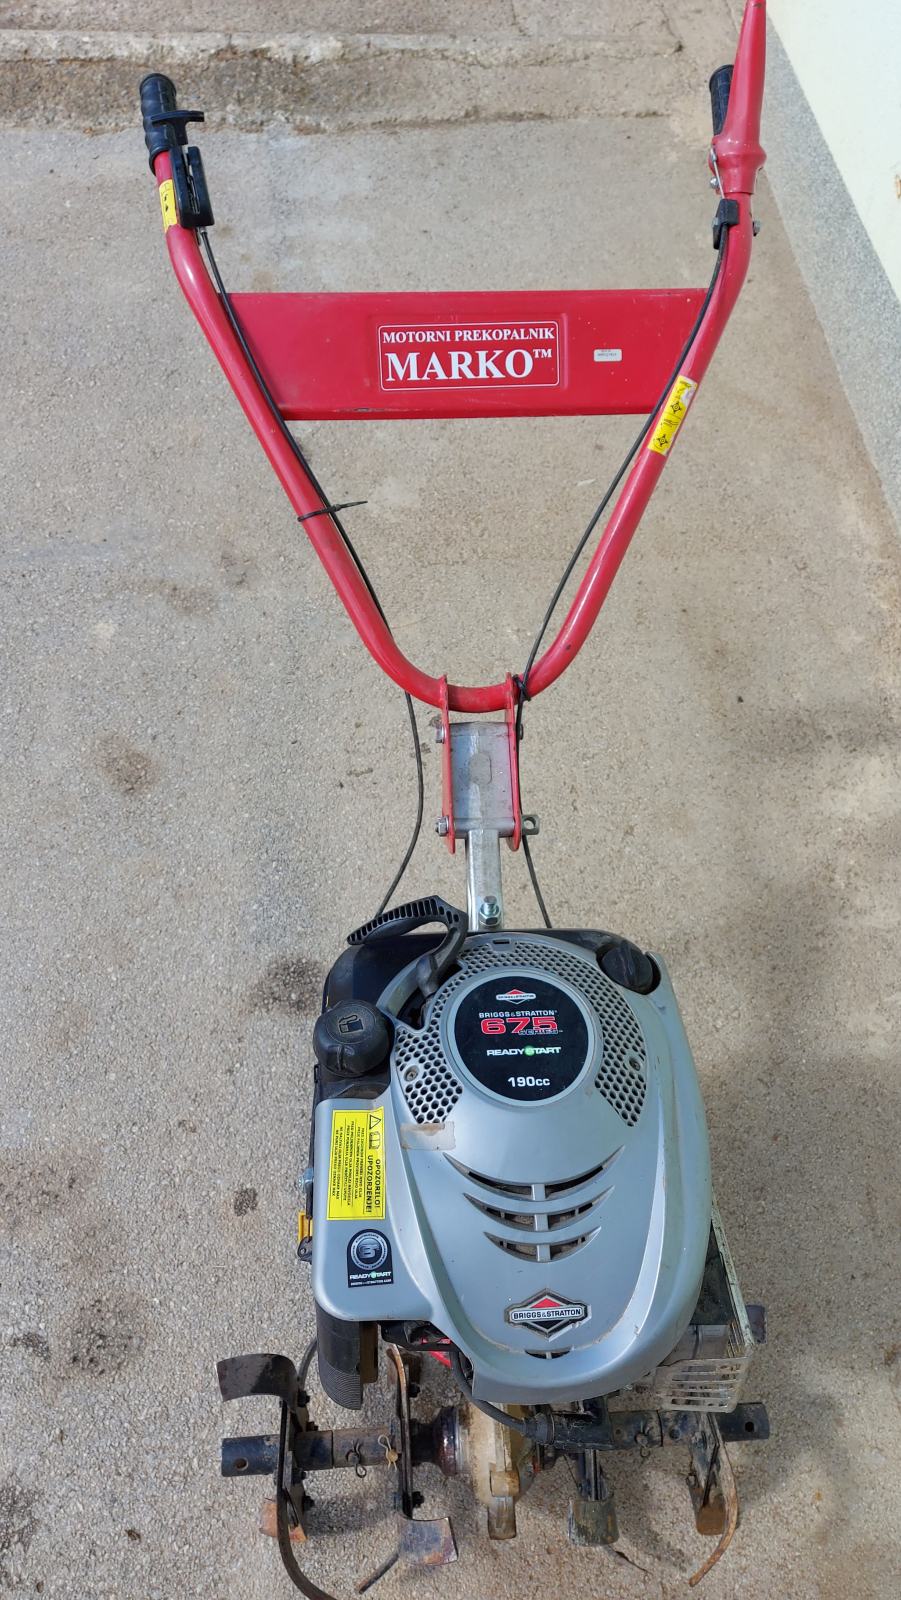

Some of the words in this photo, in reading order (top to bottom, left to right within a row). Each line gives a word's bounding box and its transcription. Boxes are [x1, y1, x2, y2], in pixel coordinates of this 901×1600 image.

[383, 329, 451, 343] MOTORNI
[454, 328, 555, 342] PREKOPALNIK
[480, 1016, 558, 1035] 675
[507, 1076, 551, 1088] 190cc
[513, 1308, 581, 1320] BRIGGS&STRATTON
